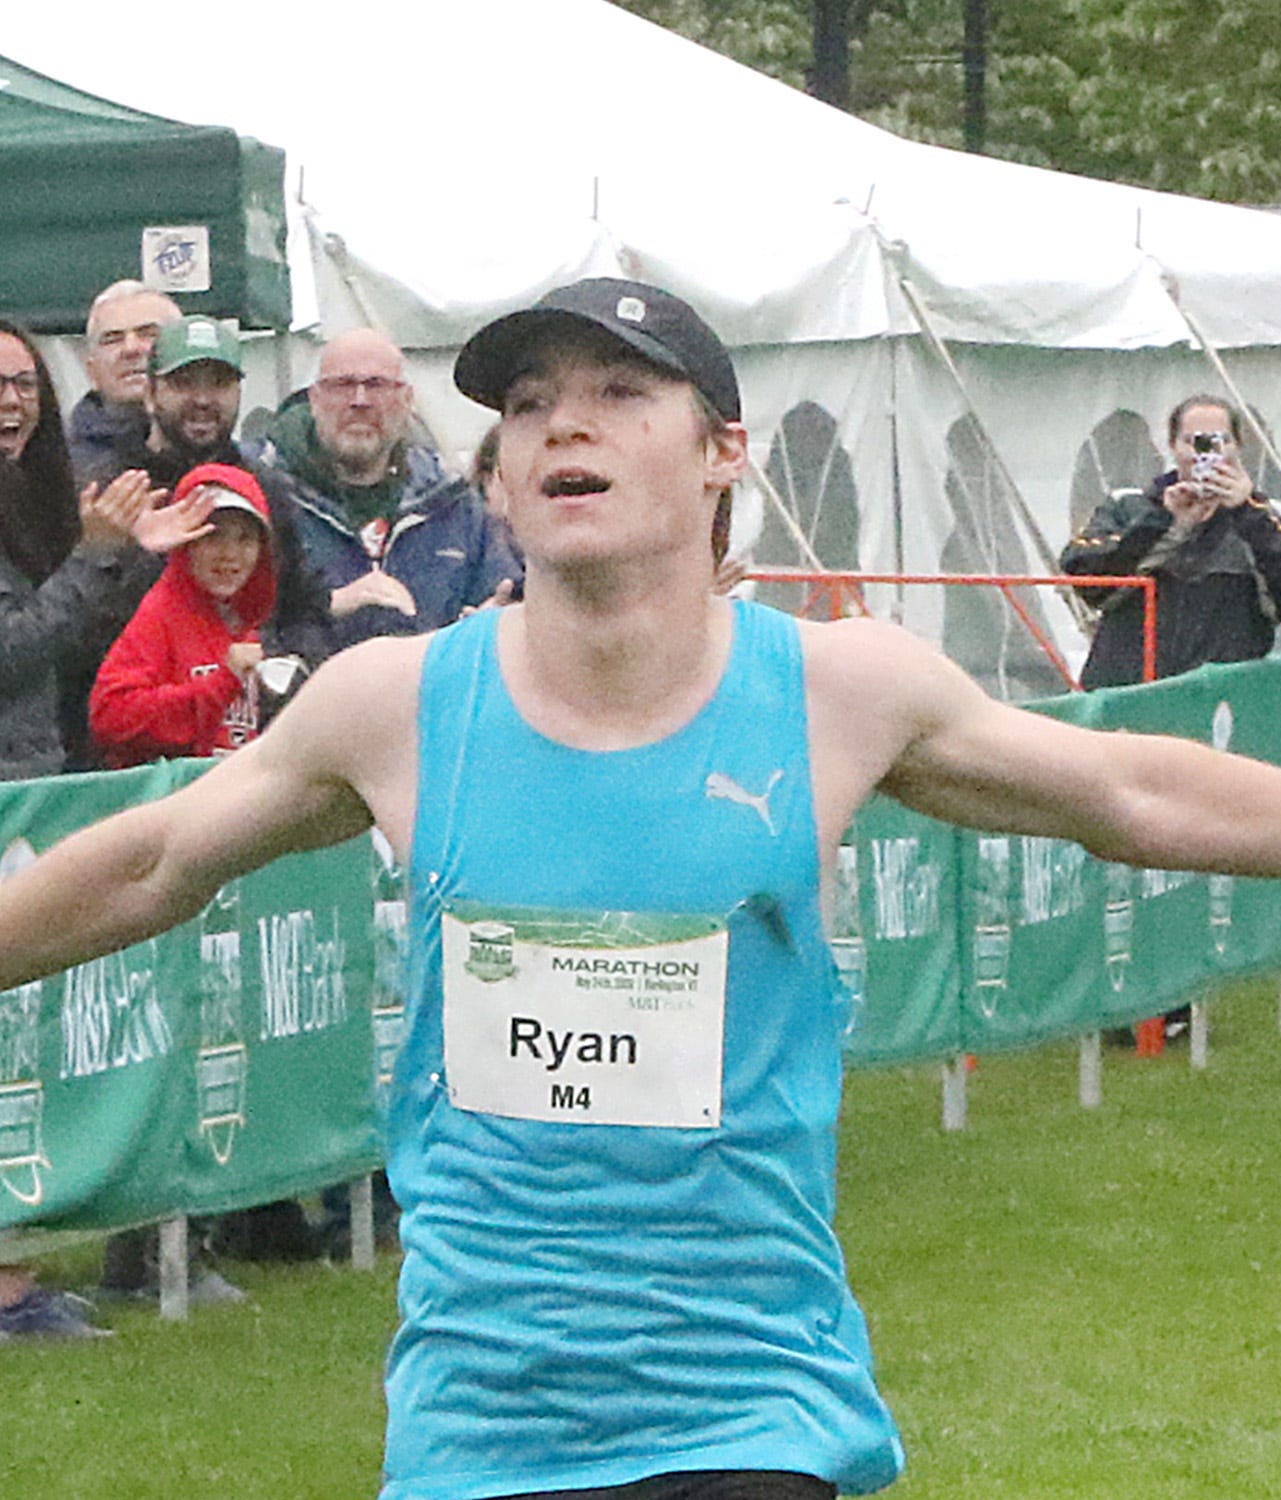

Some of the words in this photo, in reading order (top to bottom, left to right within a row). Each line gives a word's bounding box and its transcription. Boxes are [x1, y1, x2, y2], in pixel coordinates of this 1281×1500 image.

[552, 957, 700, 977] MARATHON
[510, 1016, 638, 1072] Ryan
[551, 1084, 592, 1111] M4
